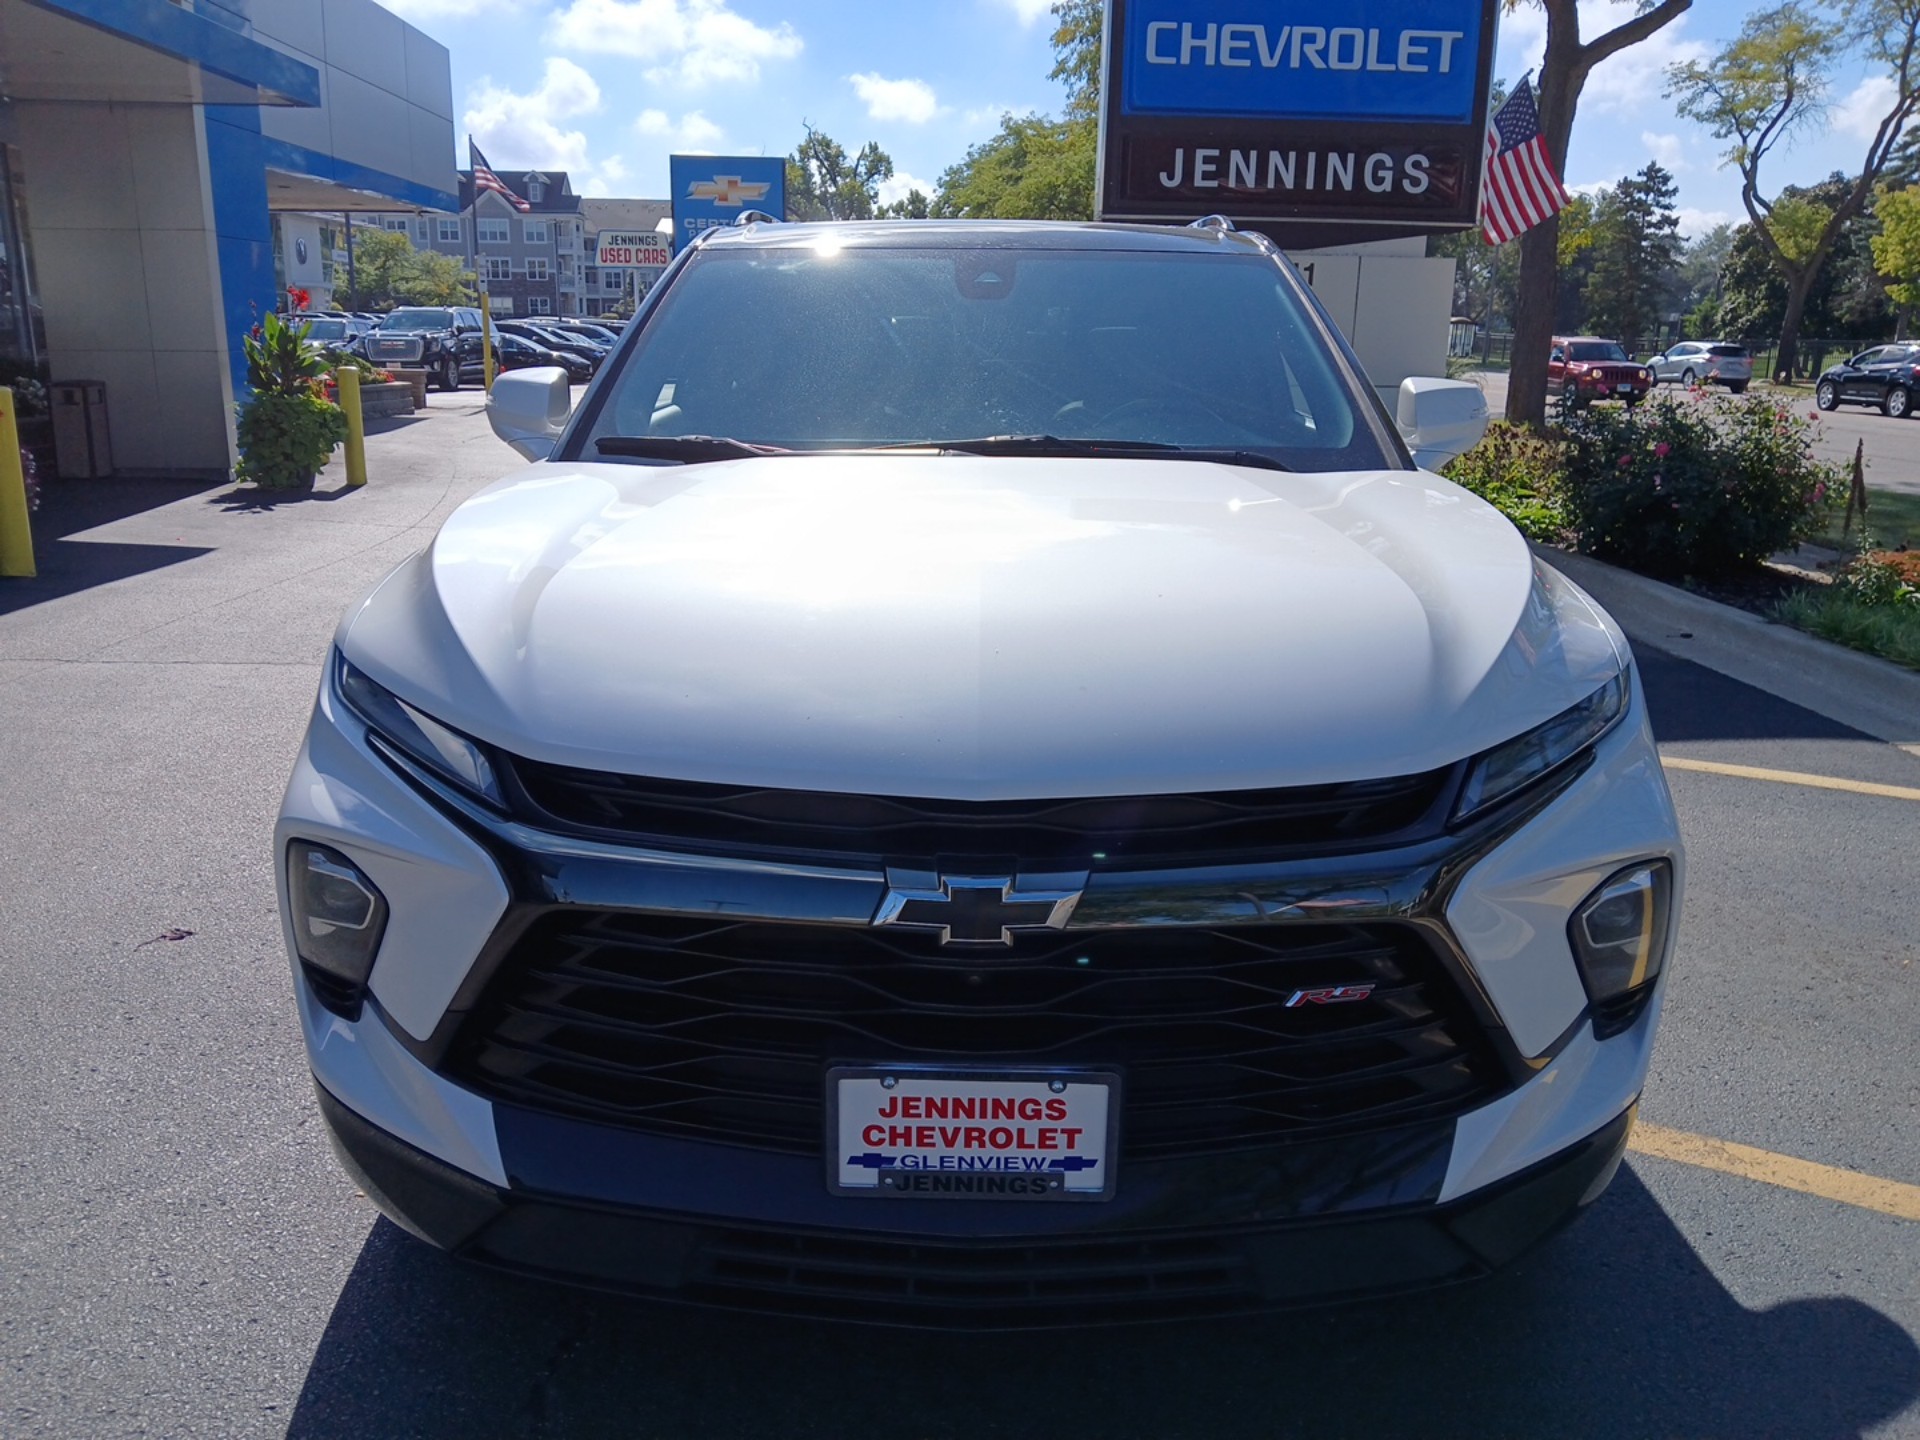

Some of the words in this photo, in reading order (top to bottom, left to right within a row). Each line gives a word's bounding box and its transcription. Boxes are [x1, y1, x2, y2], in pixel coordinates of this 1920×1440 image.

[1146, 20, 1464, 73] CHEVROLET
[1158, 147, 1431, 194] JENNINGS
[607, 235, 659, 247] JENNINGS
[600, 248, 632, 265] USED
[635, 248, 668, 265] CARS
[878, 1096, 1068, 1121] JENNINGS
[861, 1124, 1083, 1150] CHEVROLET
[900, 1154, 1048, 1171] GLENVIEW
[895, 1176, 1048, 1195] JENNINGS
